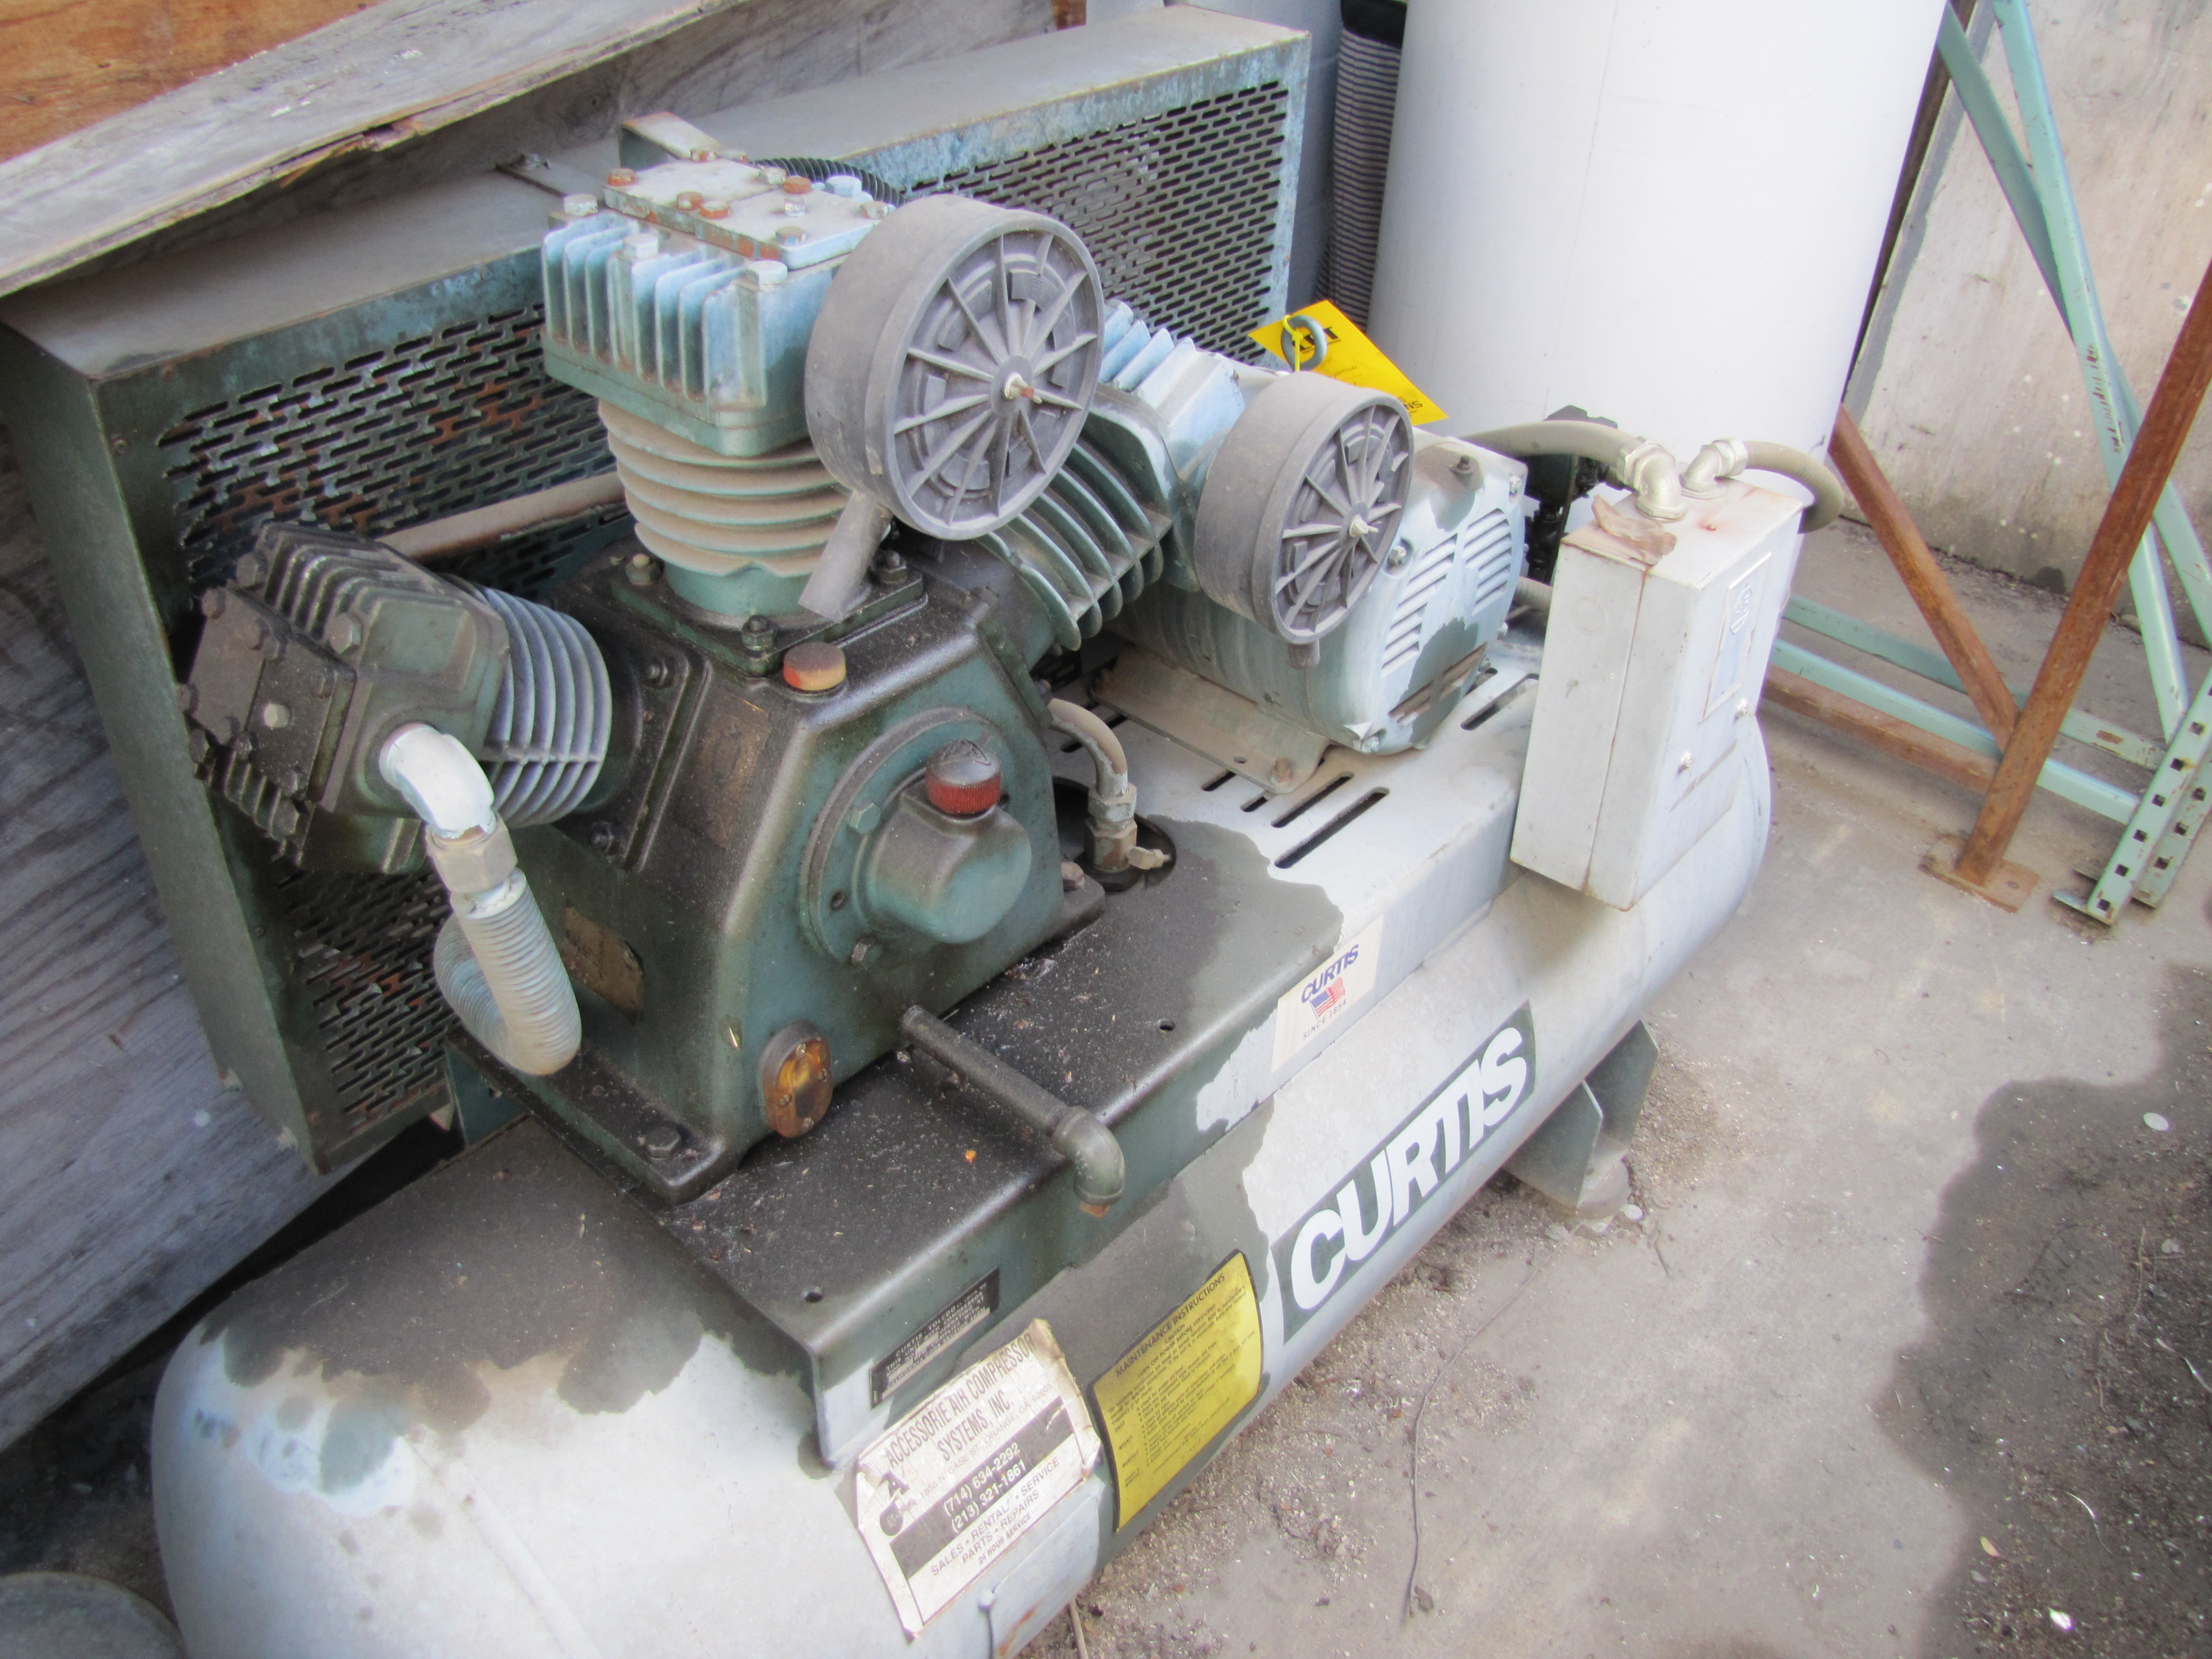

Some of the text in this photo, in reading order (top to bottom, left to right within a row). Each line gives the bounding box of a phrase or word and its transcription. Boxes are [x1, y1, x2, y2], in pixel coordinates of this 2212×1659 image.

[1301, 944, 1359, 1003] CURTIS
[1303, 998, 1347, 1040] SINCE 1854
[1291, 1027, 1527, 1310] CURTIS
[886, 1357, 900, 1370] THIS
[905, 1342, 919, 1355] UNIT
[924, 1326, 939, 1340] WITH
[943, 1291, 982, 1324] COMPRESSOR
[965, 1306, 979, 1319] WITH
[1115, 1272, 1225, 1376] MAINTENANCE INSTRUCTIONS
[1137, 1303, 1215, 1377] TURN OFF POWER BEFORE SERVICING
[1165, 1323, 1185, 1343] CAUTION
[884, 1332, 1037, 1469] ACCESSORIE AIR COMPRESSOR
[937, 1389, 1015, 1461] SYSTEMS, INC.
[948, 1454, 970, 1474] CASE
[1032, 1381, 1052, 1402] 92665
[931, 1542, 965, 1576] SALES
[1020, 1456, 1060, 1496] SERVICE
[944, 1442, 1021, 1517] (714) 634-2292
[951, 1459, 1026, 1534] (213) 321-1861
[962, 1489, 1040, 1563] PARTS REPAIRS
[978, 1512, 1032, 1565] 24 HOUR SERVICE
